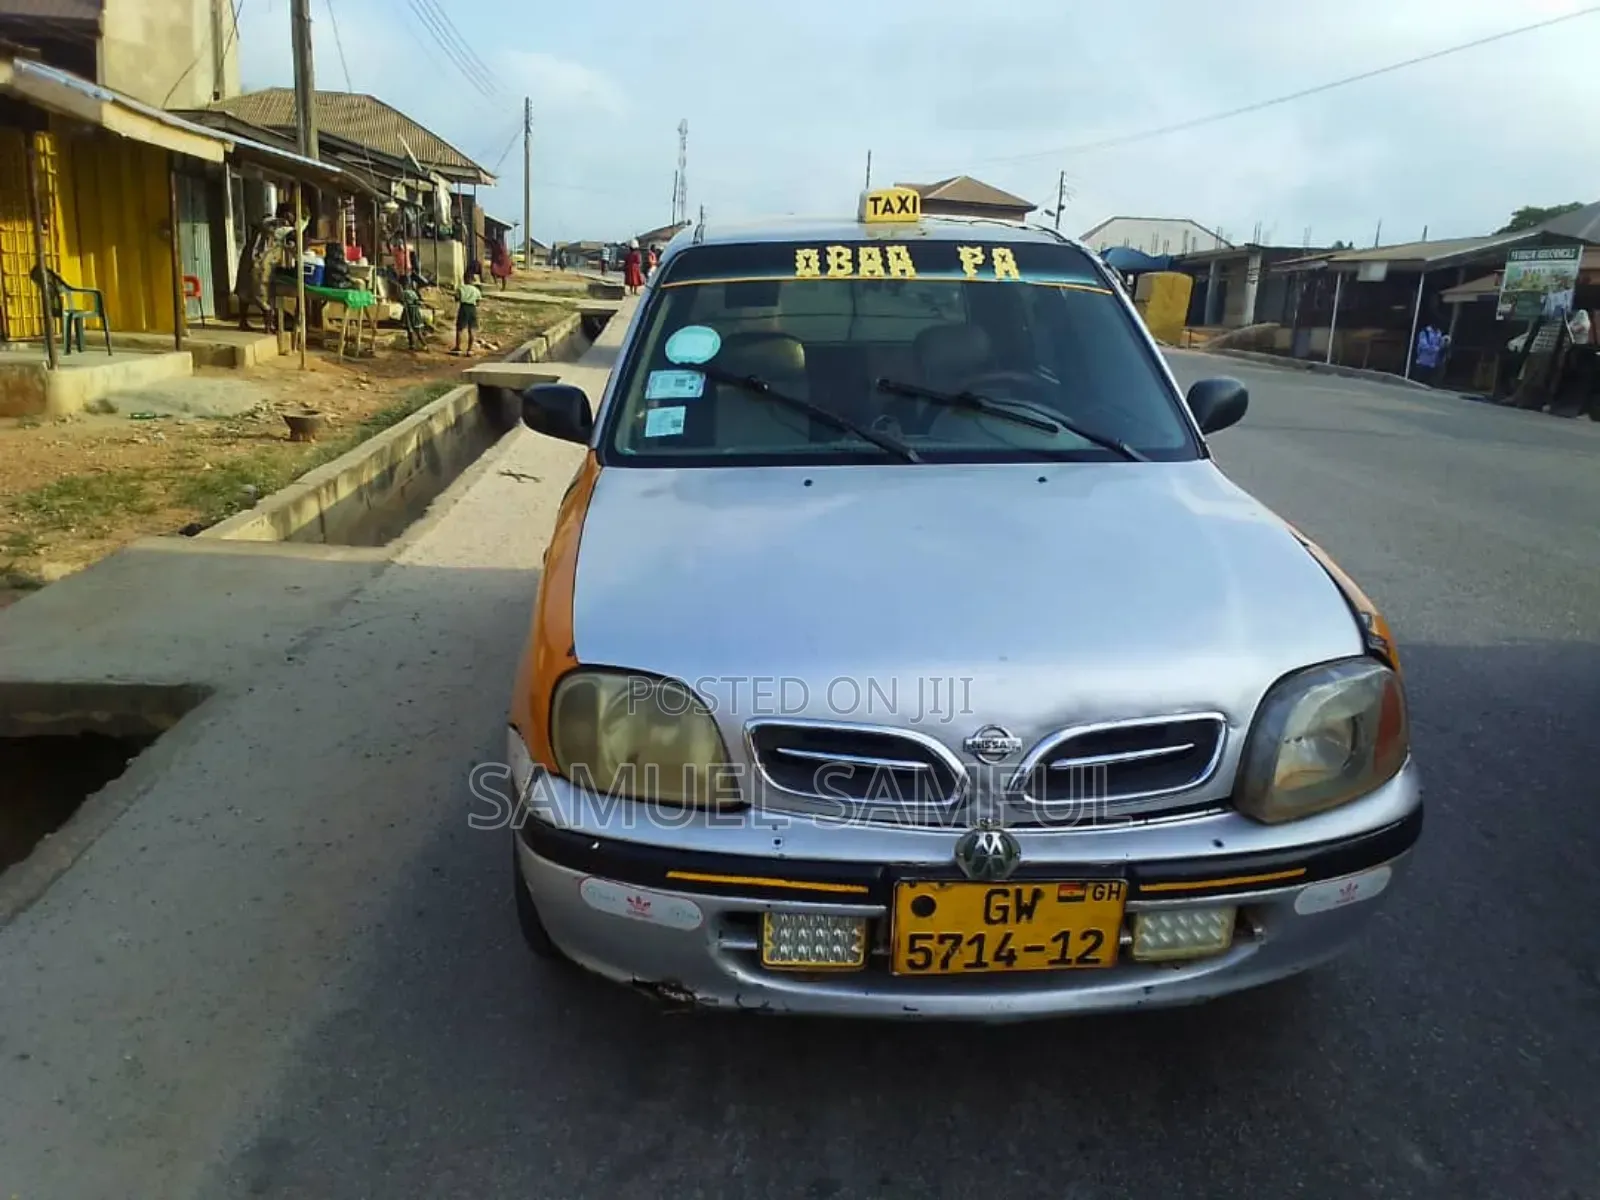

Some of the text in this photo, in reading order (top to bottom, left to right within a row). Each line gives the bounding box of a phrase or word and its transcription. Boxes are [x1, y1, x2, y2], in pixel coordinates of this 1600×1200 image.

[869, 196, 917, 215] TAXI
[957, 246, 1020, 280] PA
[983, 887, 1044, 926] GW
[1092, 884, 1122, 901] GH
[905, 928, 1105, 971] 5714-12
